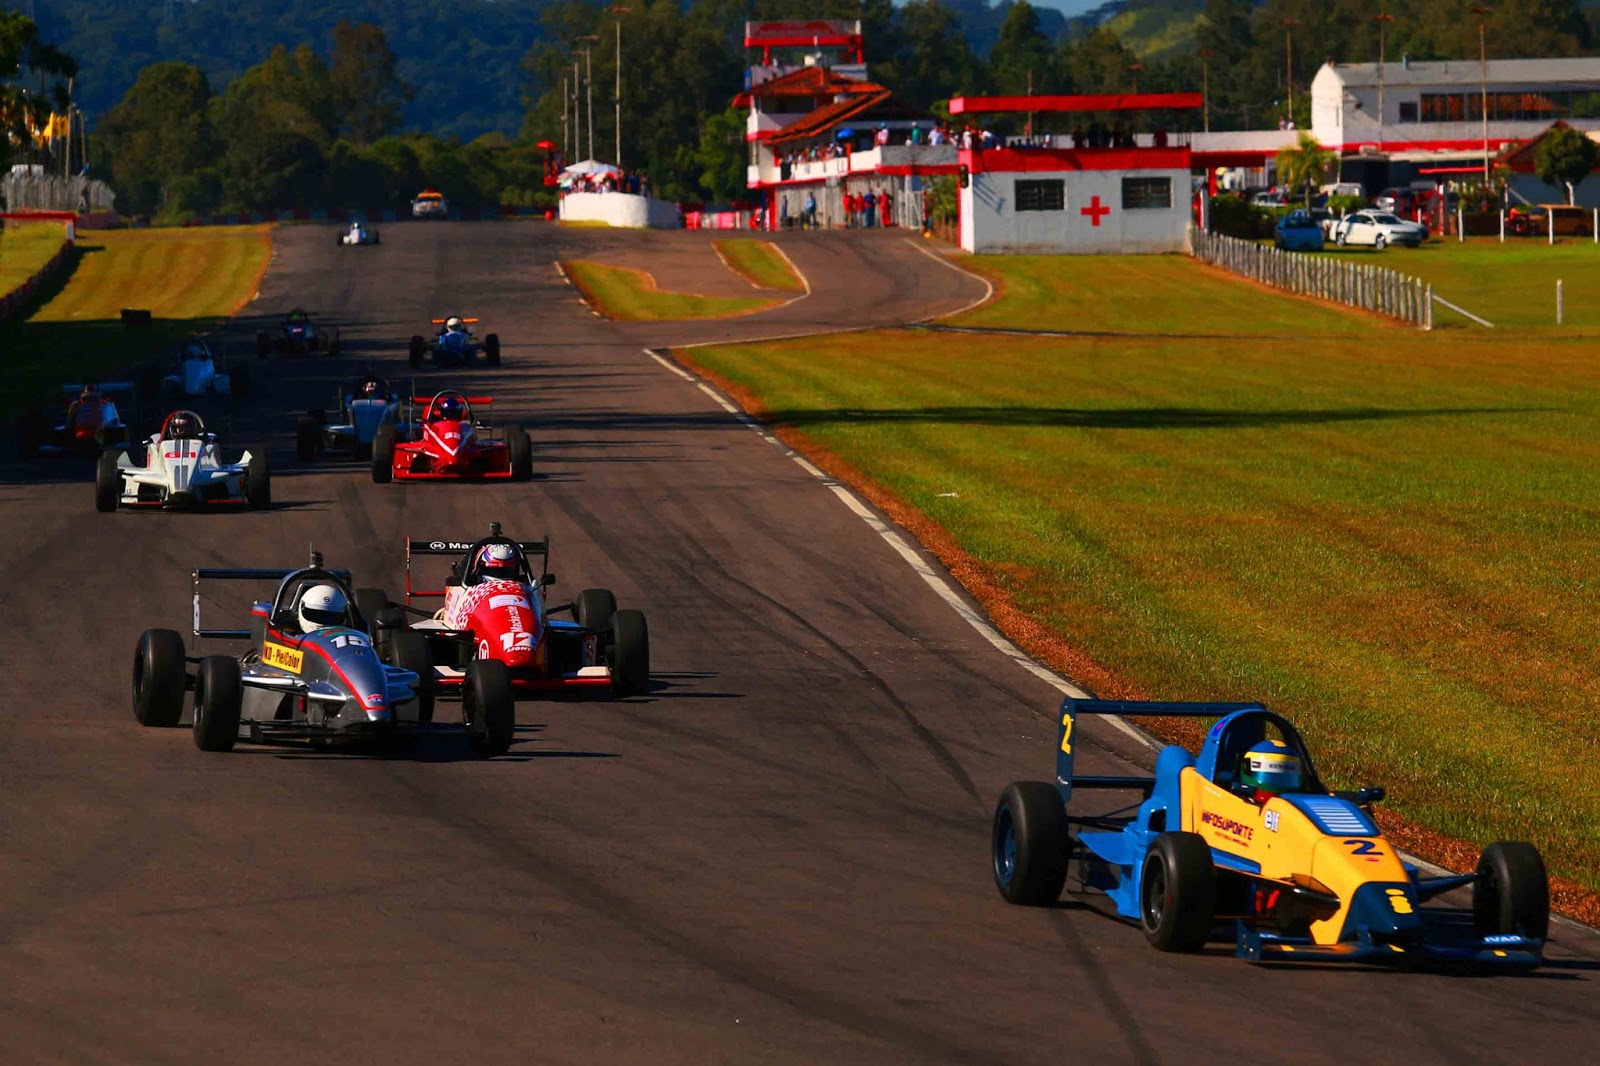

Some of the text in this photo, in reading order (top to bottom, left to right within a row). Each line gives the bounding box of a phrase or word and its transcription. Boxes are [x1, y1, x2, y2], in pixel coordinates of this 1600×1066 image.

[330, 635, 370, 648] 15
[500, 632, 534, 651] 12
[1061, 713, 1072, 754] 2
[1264, 809, 1280, 833] elf
[1343, 839, 1384, 855] 2
